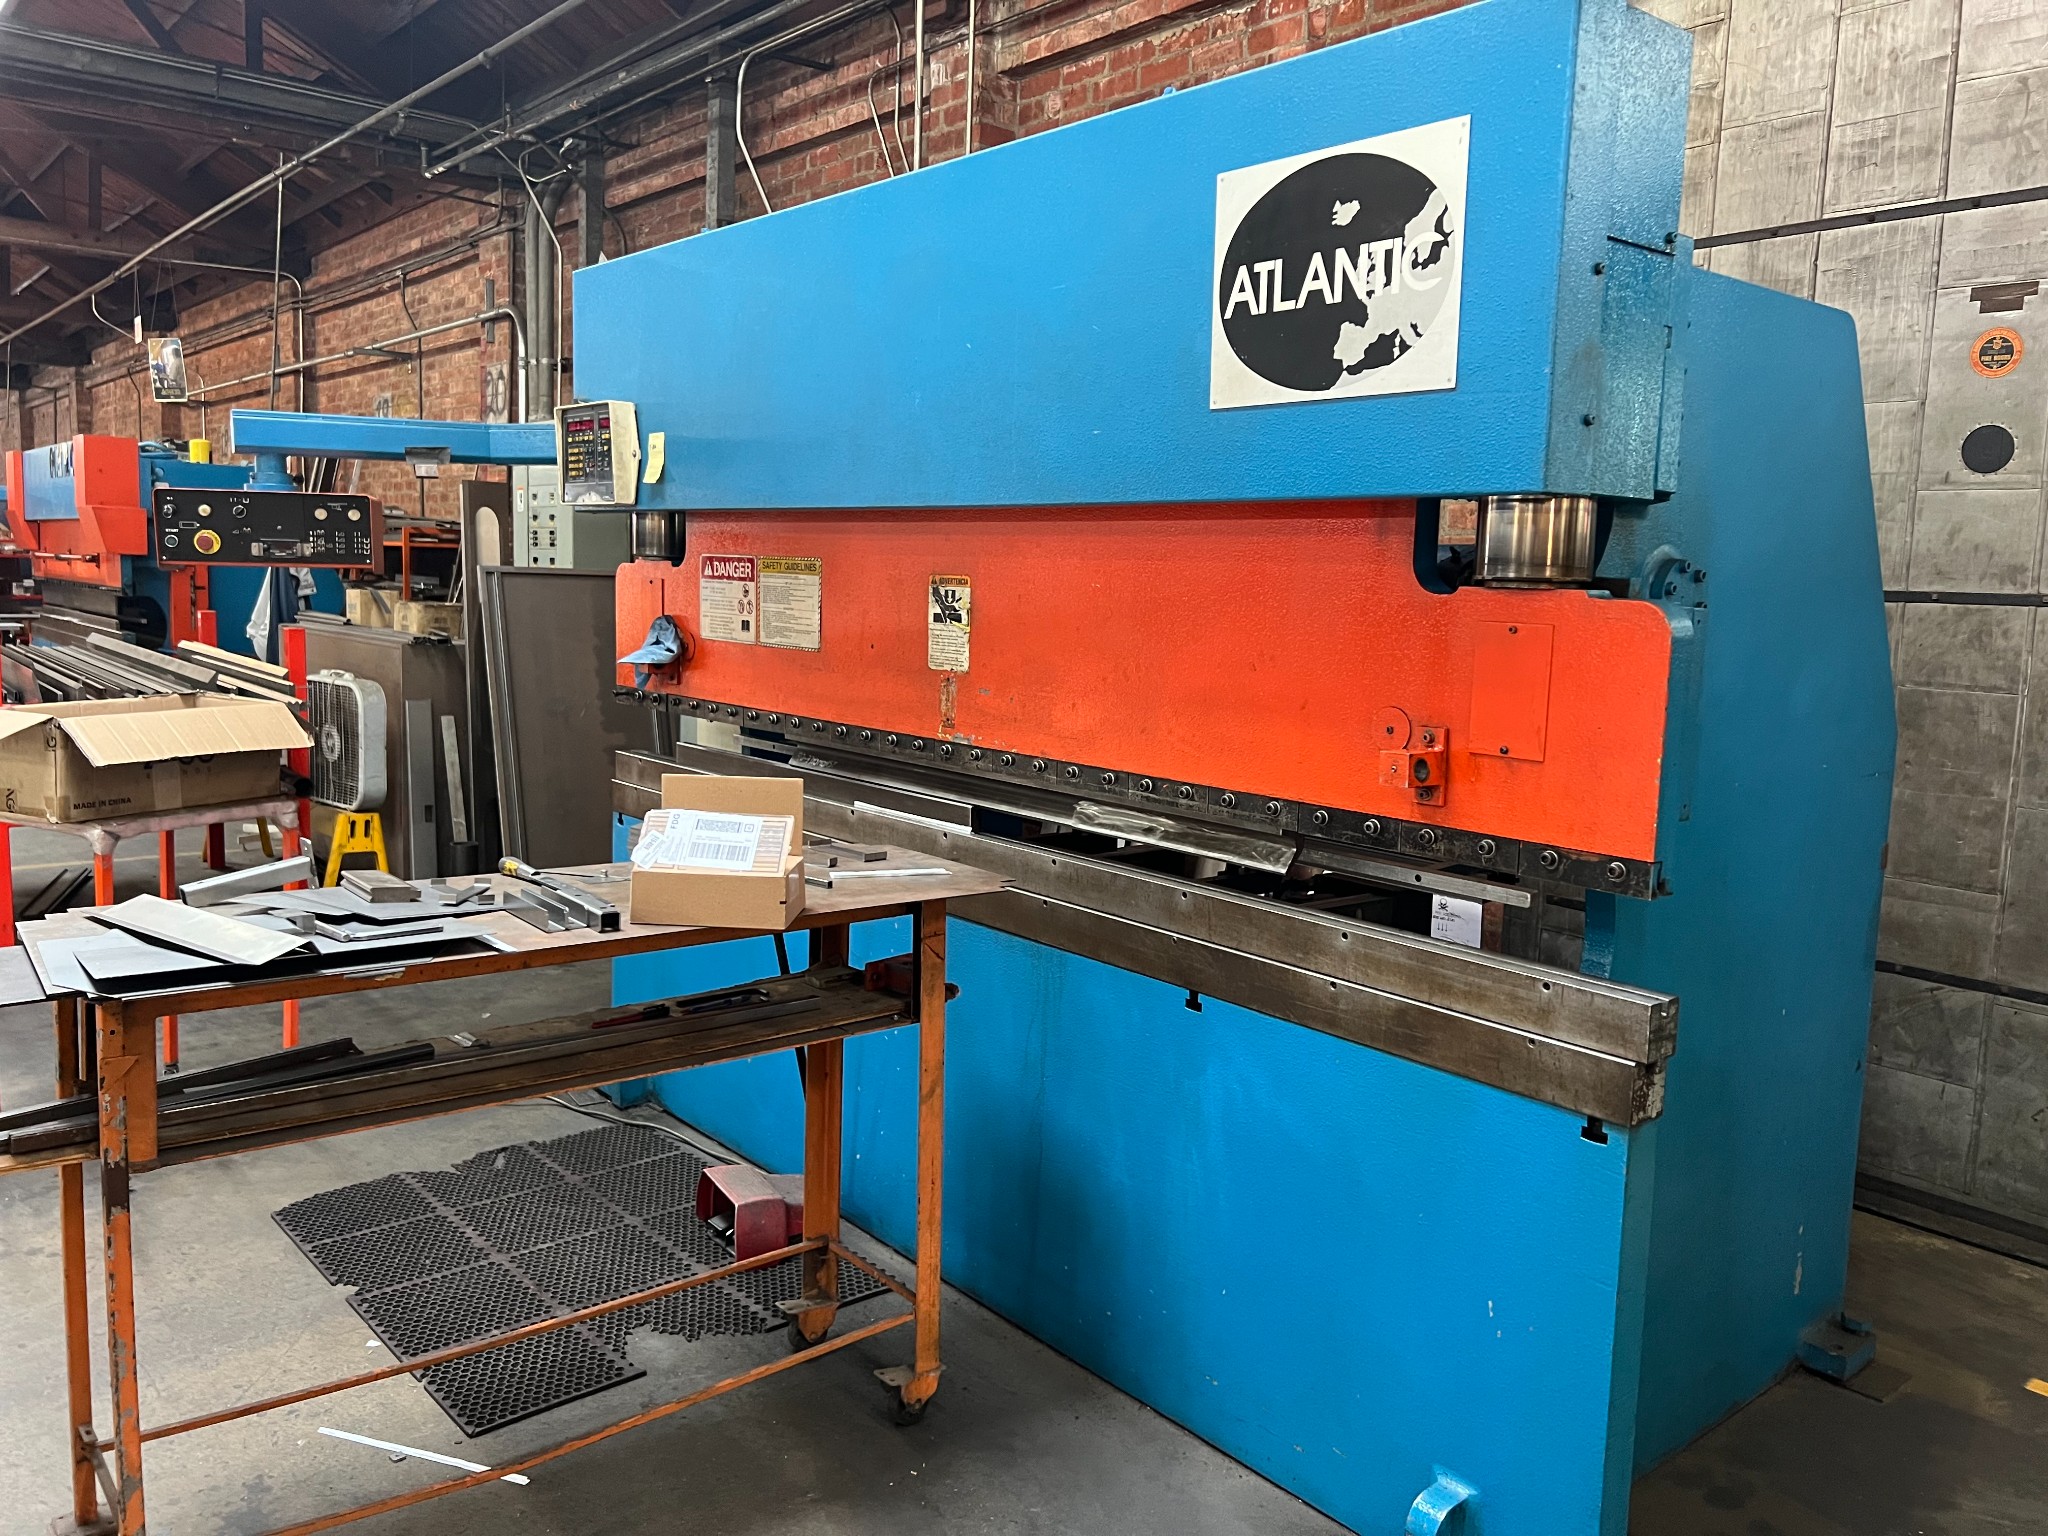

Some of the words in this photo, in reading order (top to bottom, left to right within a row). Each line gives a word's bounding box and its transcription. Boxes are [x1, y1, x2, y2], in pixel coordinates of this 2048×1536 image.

[1224, 231, 1445, 319] ATLANTIC
[713, 561, 752, 578] DANGER
[762, 561, 783, 570] SAFETY
[784, 562, 817, 572] GUIDELINES
[73, 801, 97, 810] MADE
[98, 800, 107, 808] IN
[108, 797, 132, 806] CHINA
